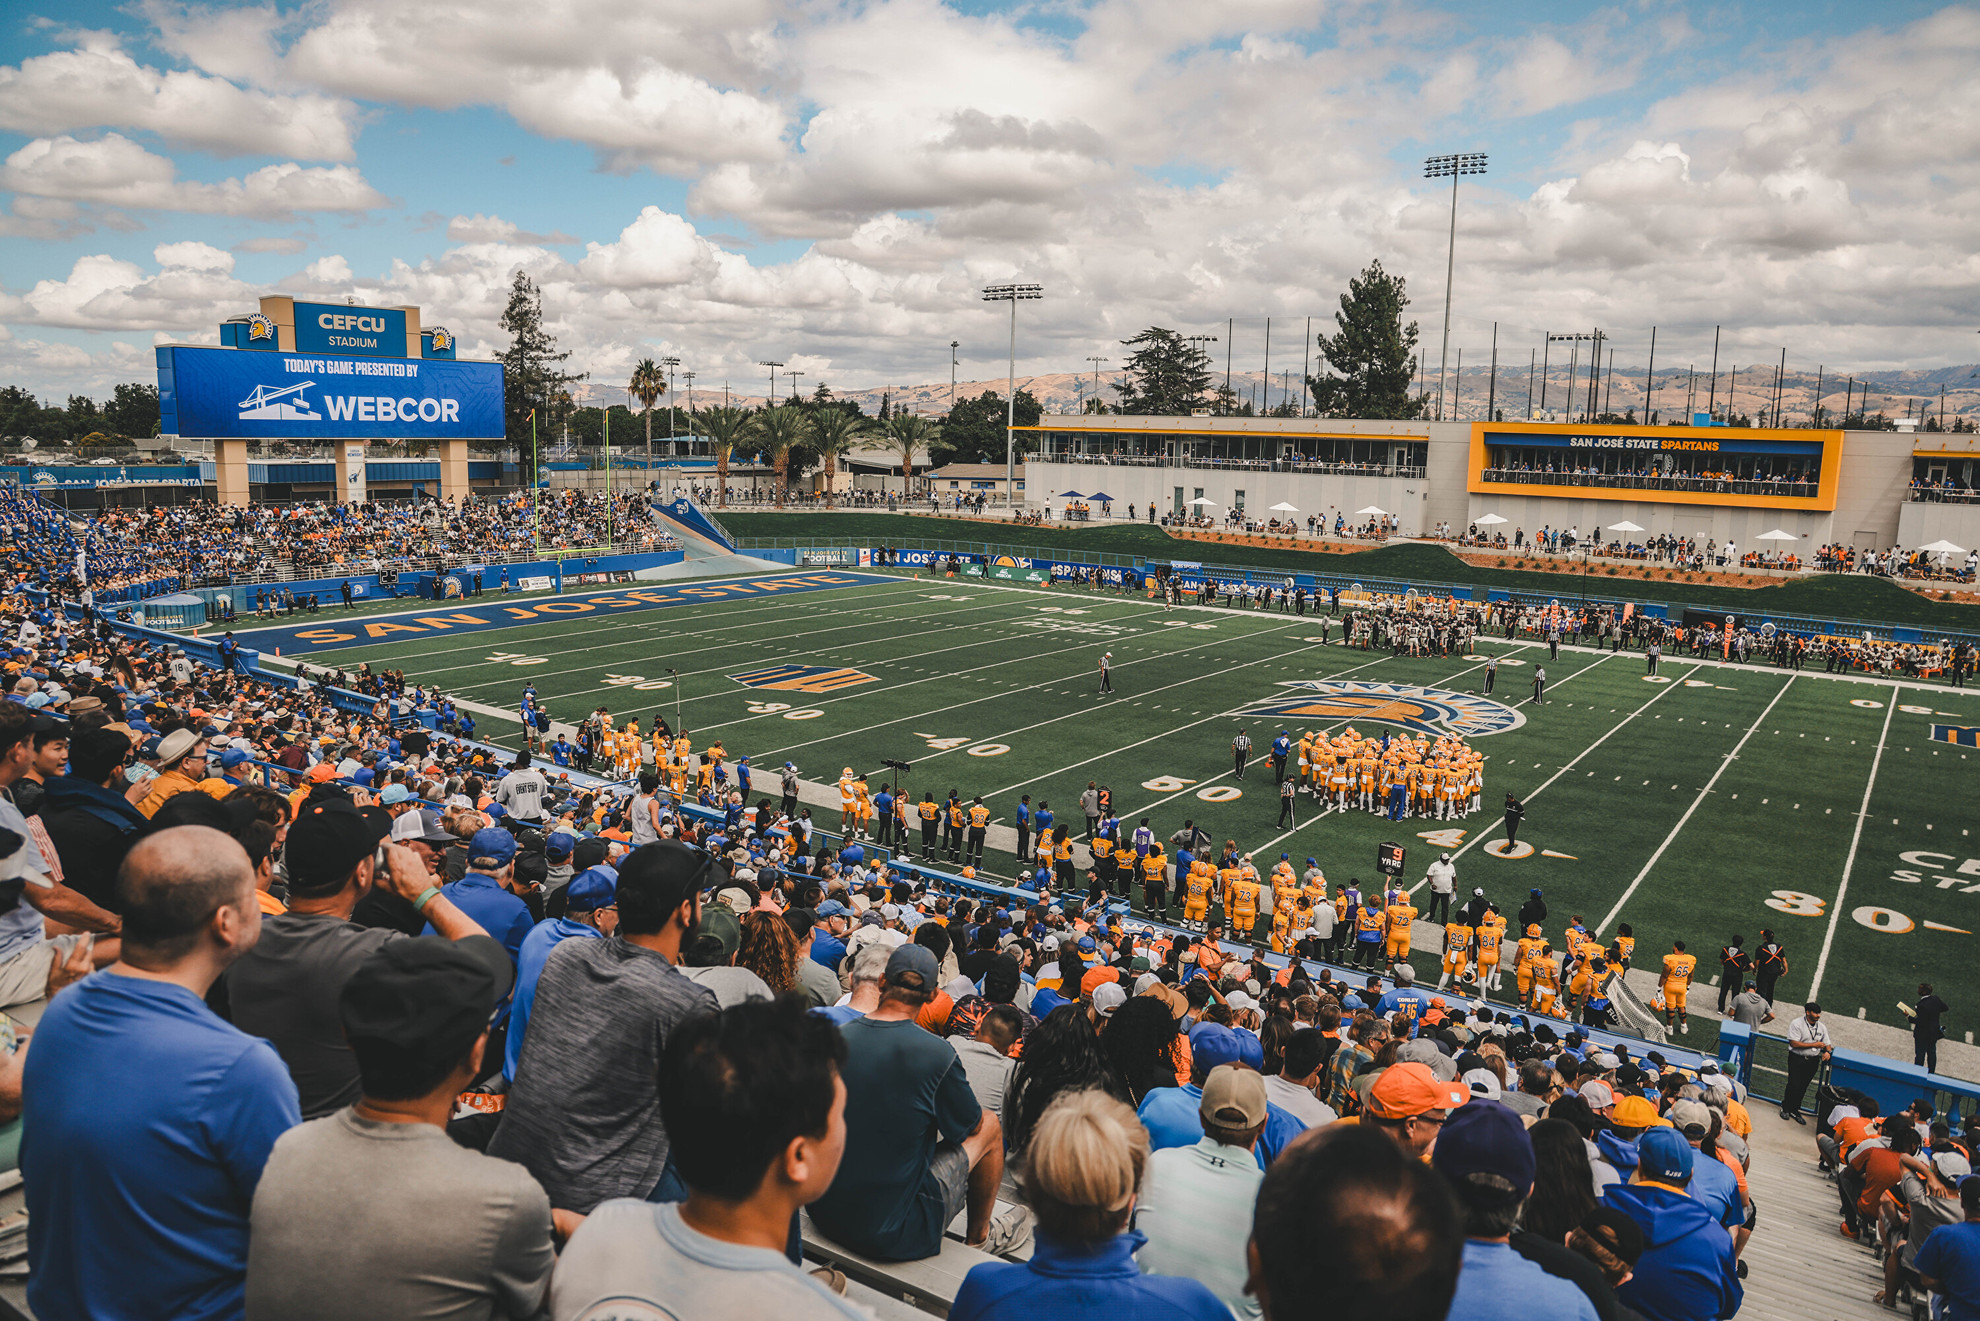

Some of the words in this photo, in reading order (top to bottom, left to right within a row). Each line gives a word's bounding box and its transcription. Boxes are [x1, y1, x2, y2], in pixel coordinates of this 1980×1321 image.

[318, 313, 386, 333] CEFCU
[328, 336, 377, 348] STADIUM
[284, 358, 325, 374] TODAY'S
[327, 361, 354, 375] GAME
[356, 362, 405, 377] PRESENTED
[406, 365, 418, 377] BY
[324, 395, 460, 422] WEBCOR
[1570, 437, 1594, 447] SAN
[1594, 436, 1624, 448] JOSÉ
[1625, 439, 1658, 449] STATE
[1660, 440, 1719, 451] SPARTANS
[903, 552, 929, 564] JOS
[381, 569, 398, 583] 25
[294, 613, 491, 644] SAN
[502, 591, 687, 620] JOSÉ
[676, 575, 860, 598] STATE
[175, 664, 183, 672] 18
[1363, 764, 1372, 773] 28
[1396, 771, 1405, 780] 45
[1426, 773, 1434, 782] 15
[515, 785, 527, 795] EVENT
[1099, 790, 1110, 805] 2
[974, 814, 985, 824] 83
[1096, 845, 1105, 856] 40
[1392, 848, 1403, 861] 9
[1381, 857, 1402, 868] YARD
[1147, 867, 1158, 877] 64
[1190, 883, 1202, 895] 69
[1238, 890, 1251, 902] 73
[1764, 890, 1915, 934] 30
[1296, 917, 1306, 928] 15
[1363, 918, 1376, 929] 62
[1396, 916, 1409, 927] 72
[1450, 932, 1464, 944] 89
[1482, 935, 1495, 948] 84
[1674, 965, 1689, 977] 65
[1399, 1003, 1417, 1019] 716
